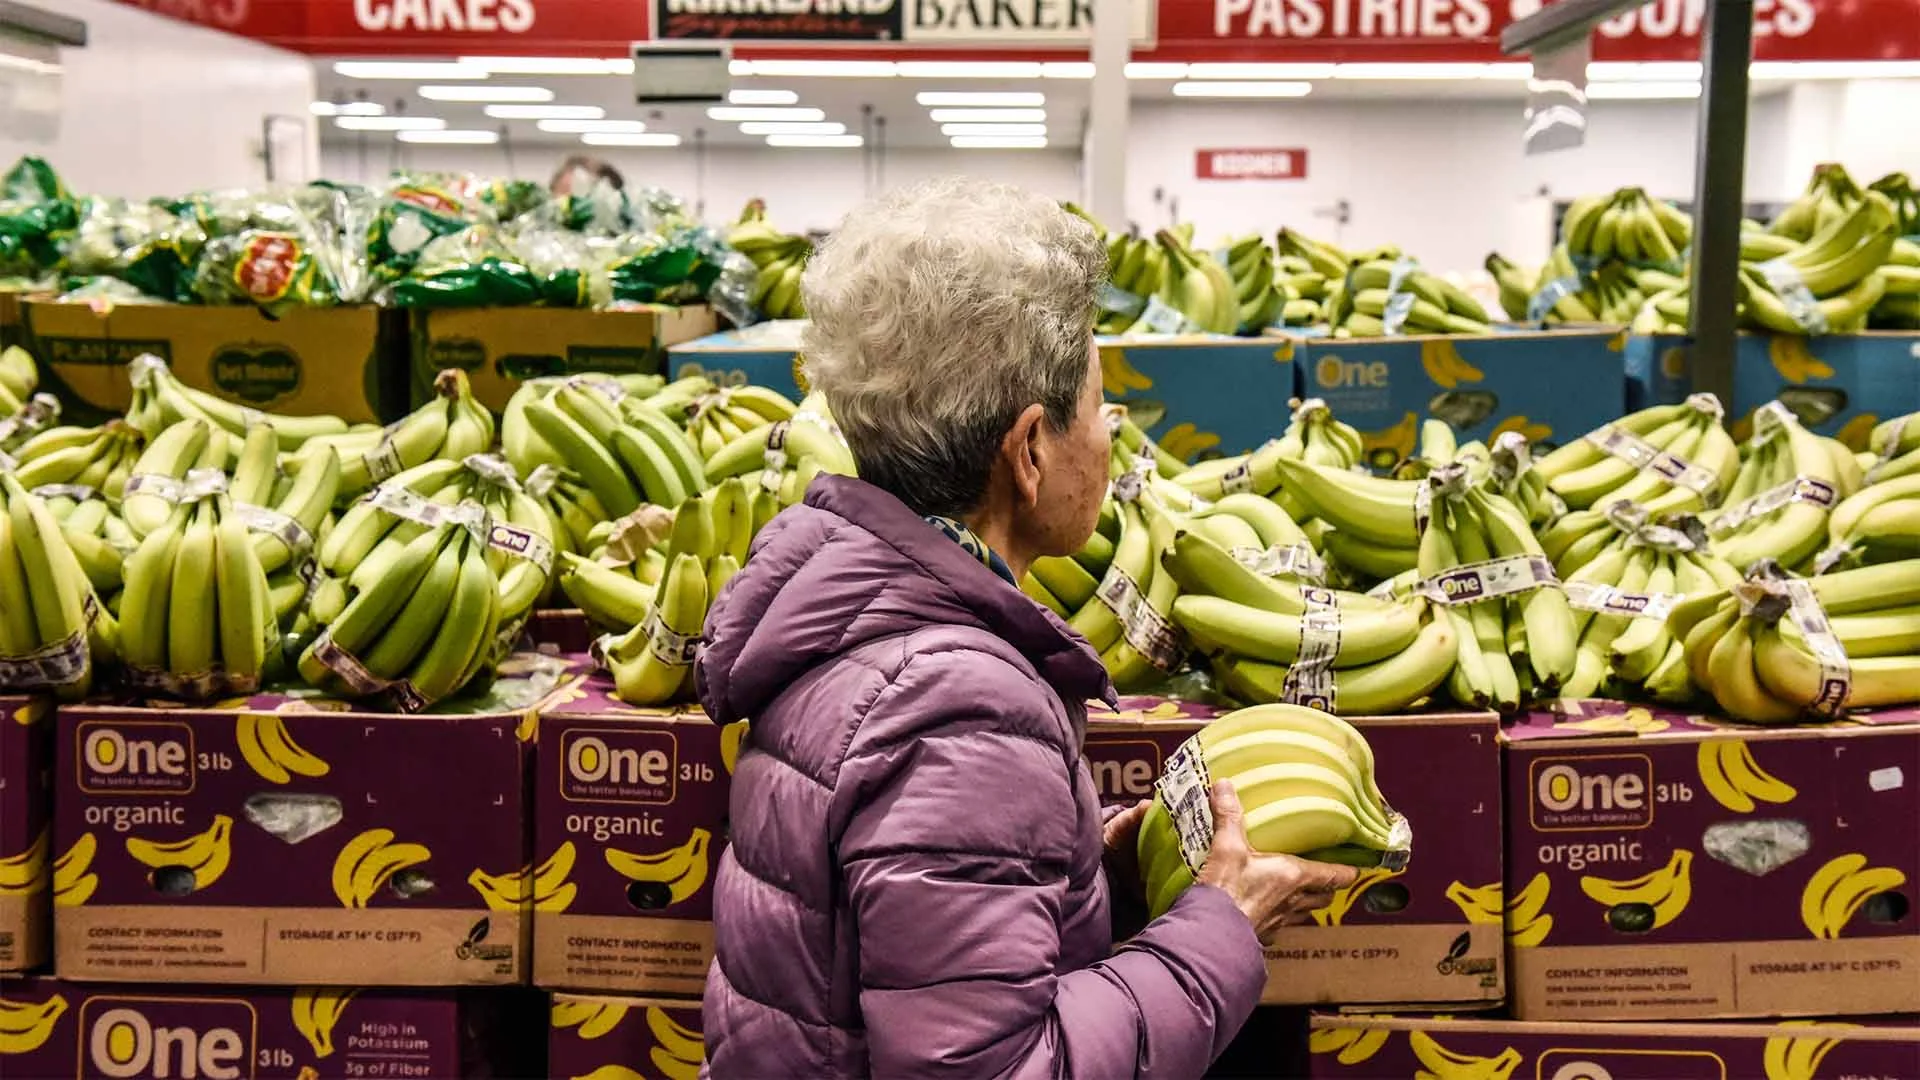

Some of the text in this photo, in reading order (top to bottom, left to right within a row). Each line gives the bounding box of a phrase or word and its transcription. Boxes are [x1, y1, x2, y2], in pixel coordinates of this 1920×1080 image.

[353, 0, 535, 32] CAKES
[912, 0, 1096, 28] BAKER
[1213, 0, 1492, 38] PASTRIES
[1316, 355, 1388, 388] One
[492, 528, 528, 549] One
[1441, 576, 1480, 595] One
[85, 729, 186, 774] One
[568, 737, 669, 784] One
[1084, 755, 1153, 795] ne
[1538, 765, 1644, 812] One
[85, 801, 185, 831] organic
[566, 812, 664, 841] organic
[1538, 837, 1642, 870] organic
[88, 928, 223, 939] CONTACT INFORMATION
[280, 930, 333, 941] STORAGE
[338, 931, 352, 941] AT
[375, 931, 383, 941] C
[567, 936, 702, 951] CONTACT INFORMATION
[1312, 949, 1327, 960] AT
[1351, 950, 1358, 960] C
[1750, 962, 1807, 975] STORAGE
[1810, 961, 1825, 972] AT
[1851, 961, 1859, 971] C
[1545, 966, 1688, 979] CONTACT INFORMATION
[348, 1036, 429, 1050] Potassium
[361, 1022, 416, 1037] High in
[91, 1008, 243, 1080] One
[346, 1062, 430, 1077] 3g of Fiber
